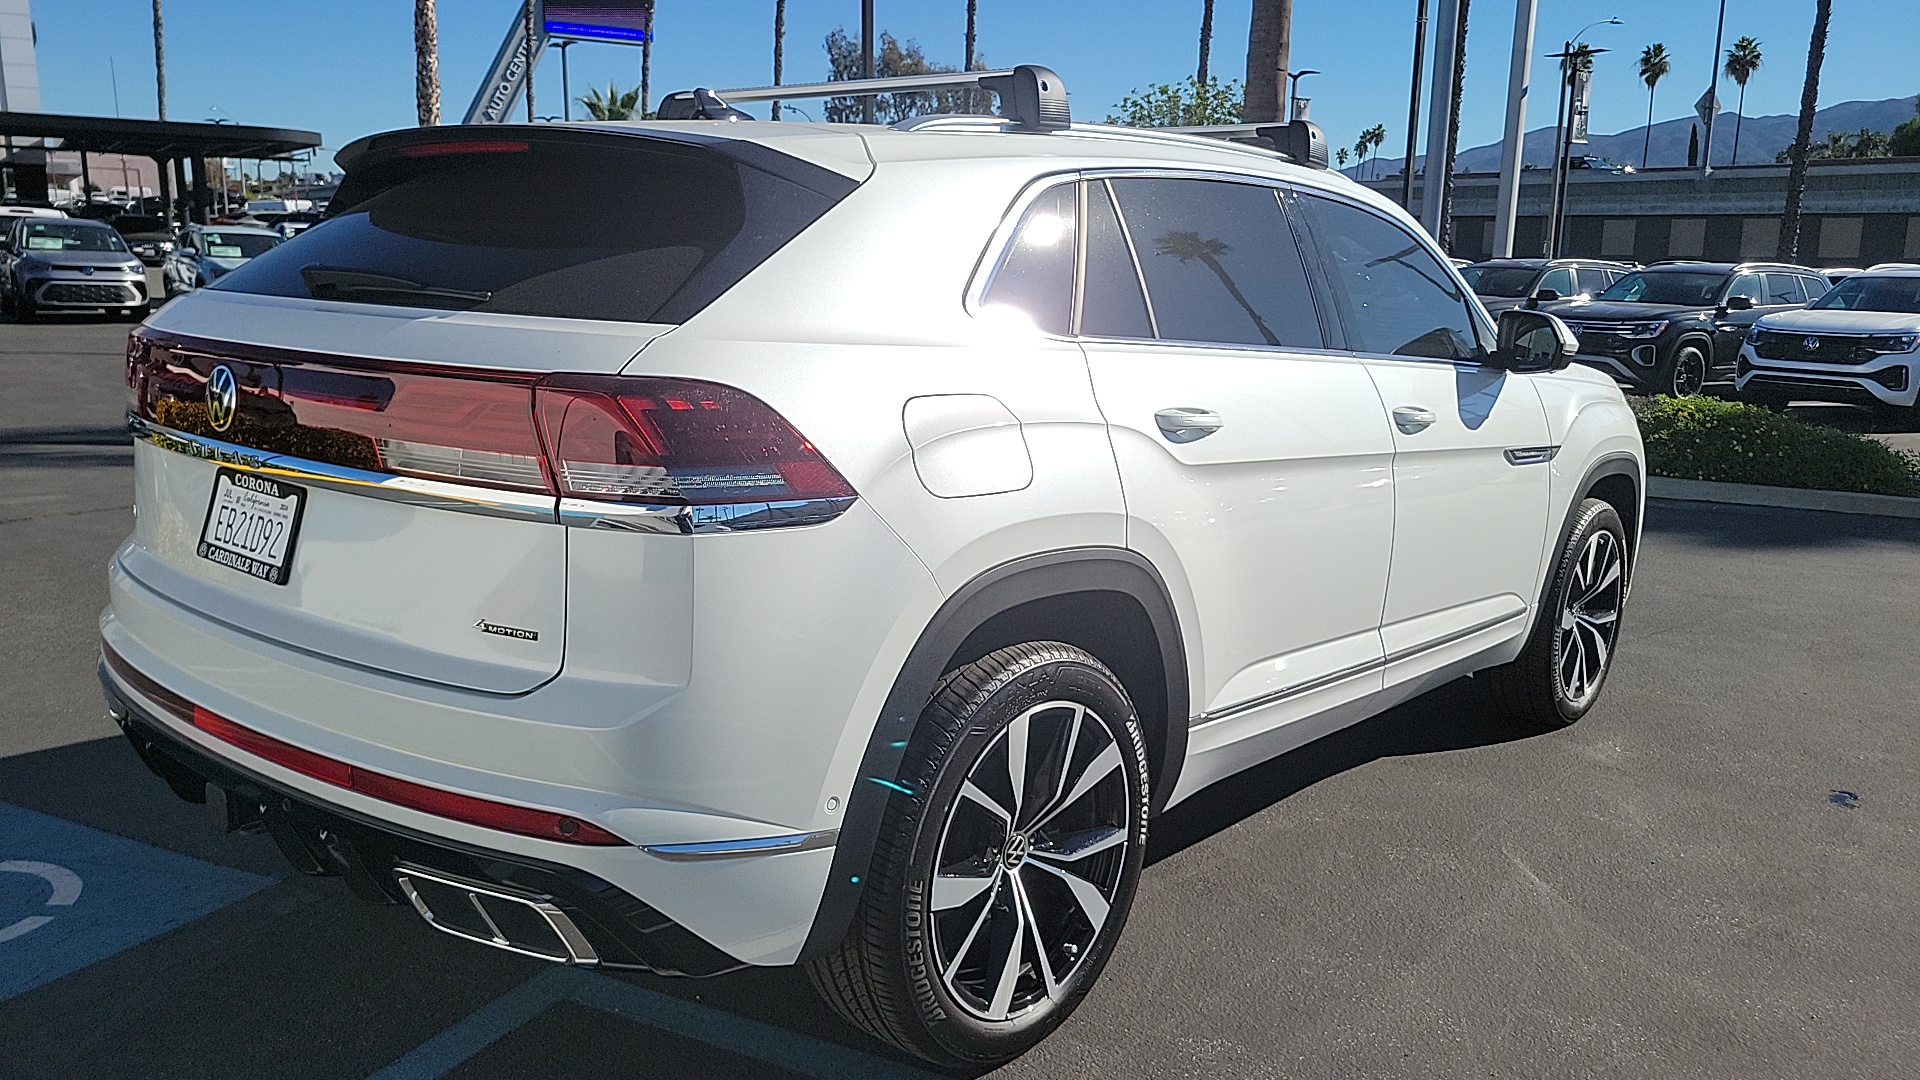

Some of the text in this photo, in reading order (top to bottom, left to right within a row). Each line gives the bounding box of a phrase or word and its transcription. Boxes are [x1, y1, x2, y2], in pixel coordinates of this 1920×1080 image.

[488, 36, 538, 120] AUTO CENT
[234, 473, 280, 497] CORONA
[207, 546, 271, 579] CARDINALE WAY
[473, 618, 535, 640] 4MOTION
